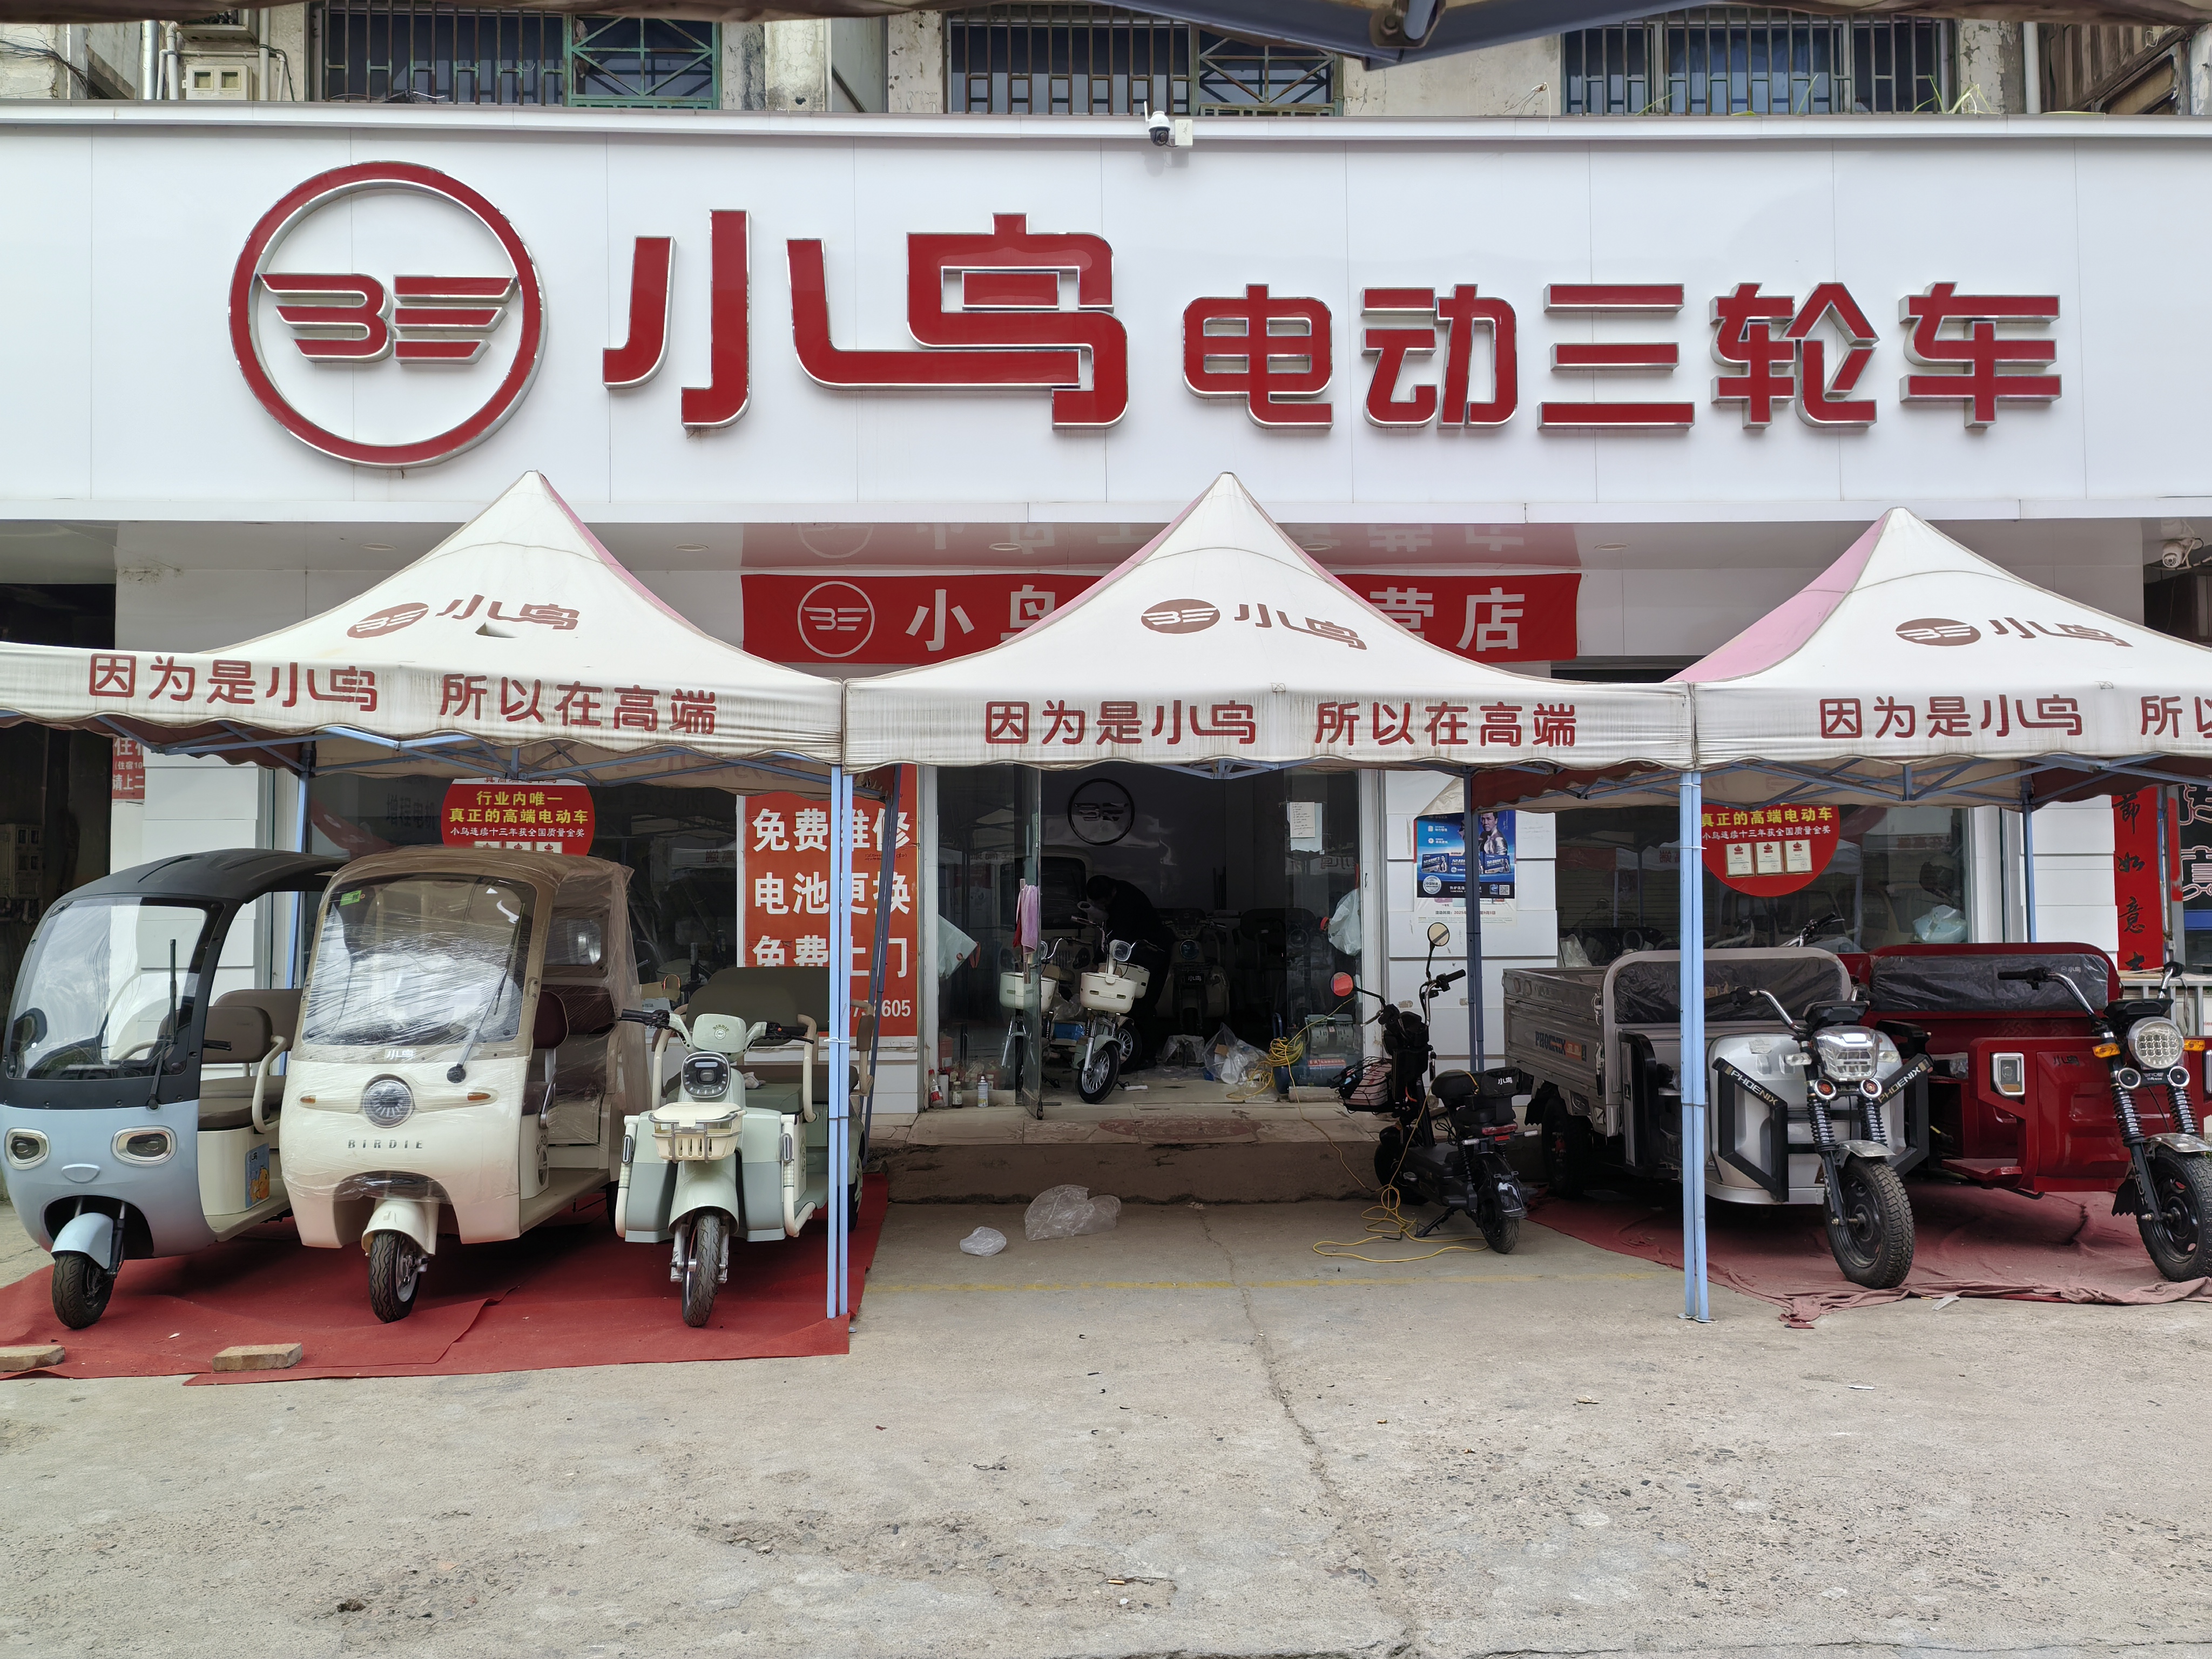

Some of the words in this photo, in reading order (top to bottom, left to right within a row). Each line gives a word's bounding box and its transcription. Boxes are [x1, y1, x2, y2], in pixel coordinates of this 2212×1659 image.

[1182, 281, 2062, 430] 电动三轮车
[89, 653, 377, 712] 因为是小鸟
[440, 672, 717, 735] 所以在高端
[986, 699, 1257, 745] 因为是小鸟
[1314, 701, 1576, 747] 所以在高端
[1819, 694, 2082, 739] 因为是小鸟
[449, 808, 589, 824] 真正的高端电动车
[476, 791, 563, 806] 行业内唯一
[1701, 806, 1833, 828] 真正的高端电动车
[1730, 1070, 1778, 1105] PHOENIX
[1878, 1067, 1920, 1103] PHOENIX
[348, 1139, 423, 1149] BIRDIE
